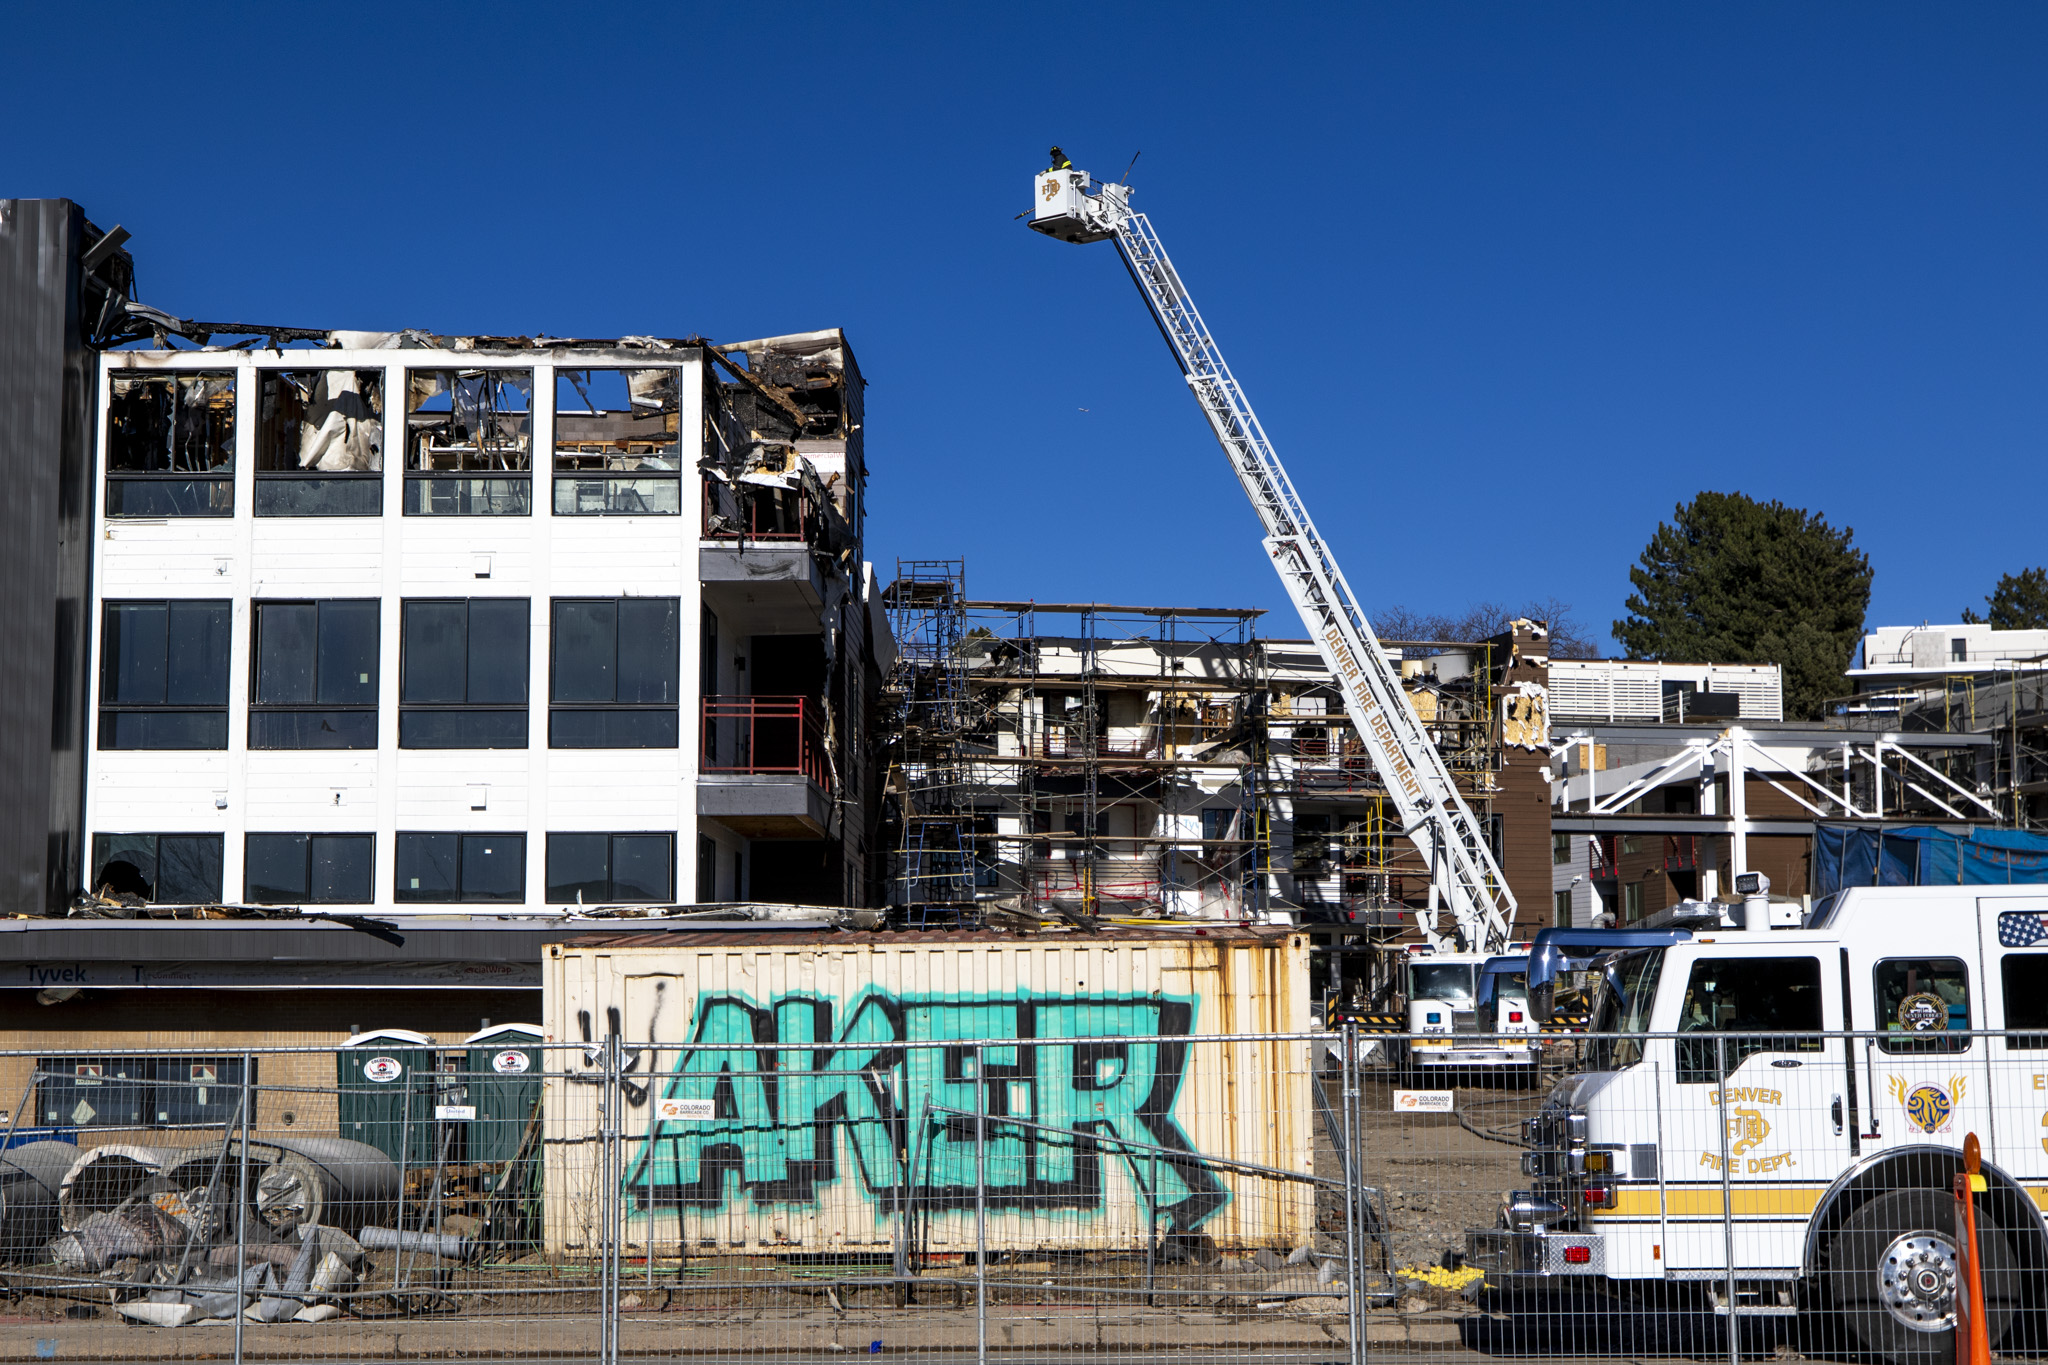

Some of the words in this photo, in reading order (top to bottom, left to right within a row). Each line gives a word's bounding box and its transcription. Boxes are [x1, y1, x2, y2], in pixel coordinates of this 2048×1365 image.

[1325, 628, 1359, 681] DENVER
[1353, 681, 1377, 713] FIRE
[1370, 714, 1422, 797] DEPARTMENT
[26, 964, 87, 986] Tyvek
[1708, 1087, 1783, 1106] DENVER
[1747, 1151, 1797, 1174] DEPT.
